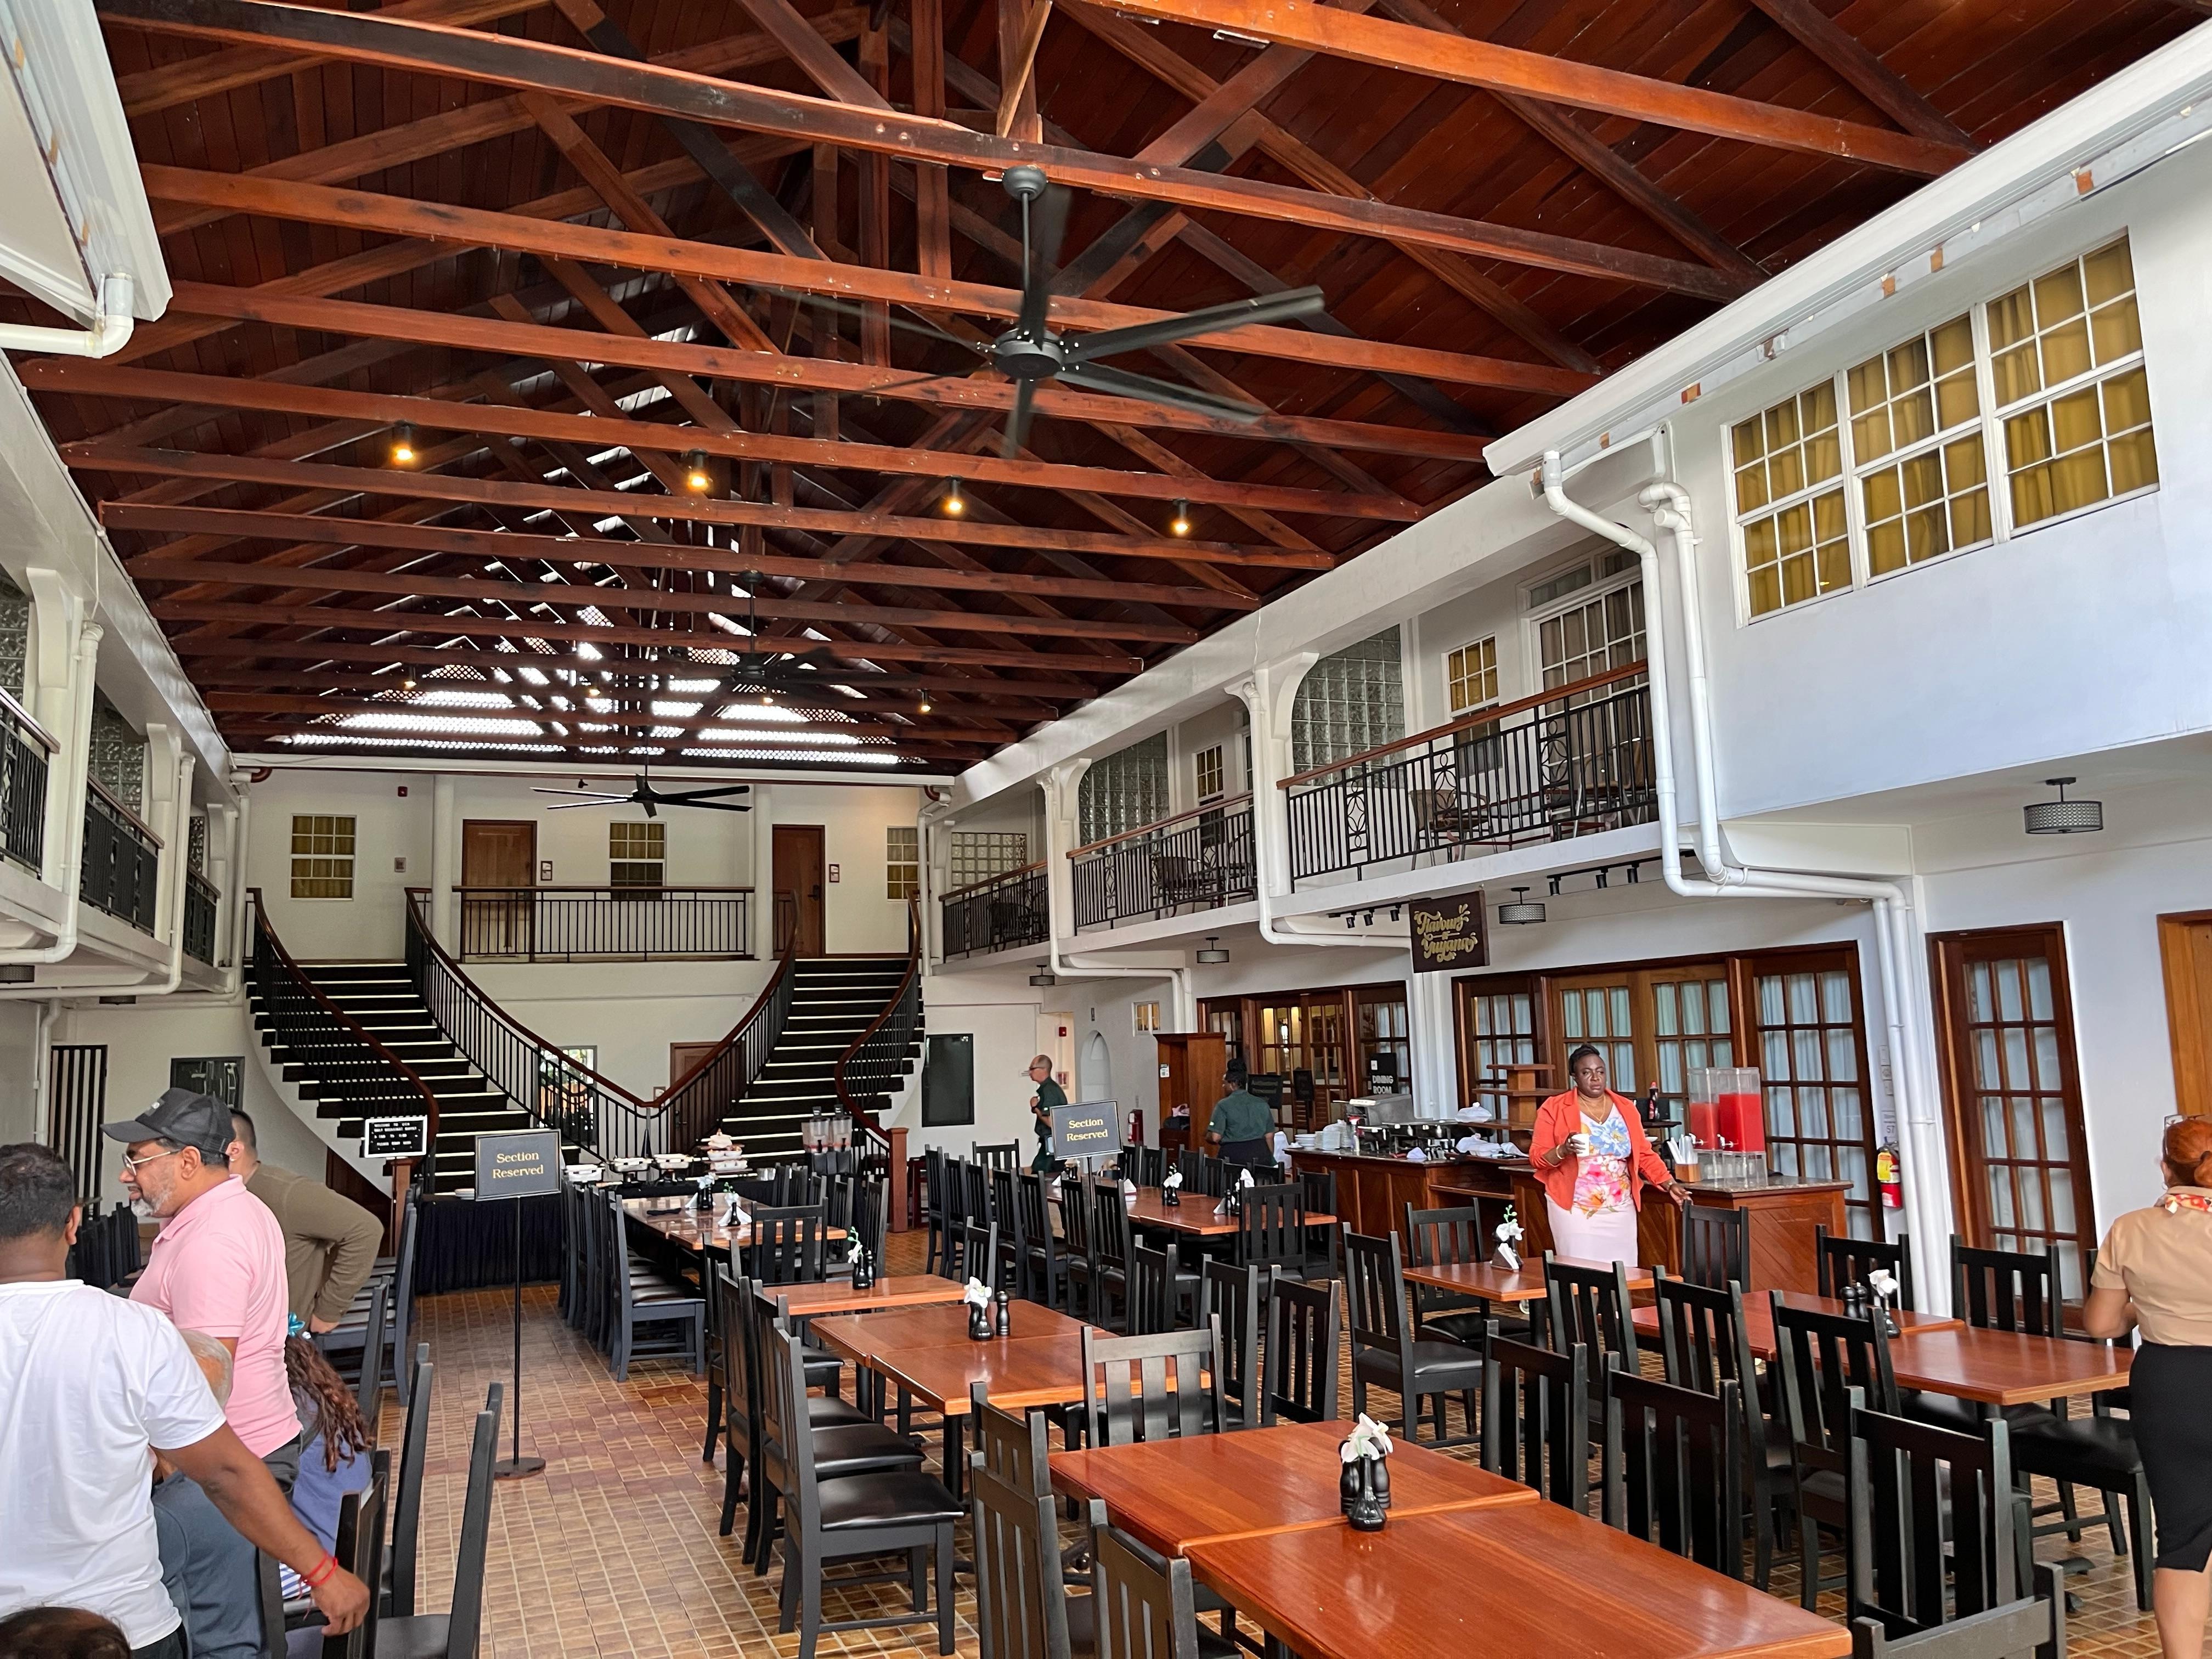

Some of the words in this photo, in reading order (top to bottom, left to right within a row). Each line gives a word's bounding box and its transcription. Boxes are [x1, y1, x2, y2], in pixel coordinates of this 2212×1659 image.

[1414, 910, 1470, 935] Flavours
[1373, 1086, 1392, 1094] ROOM
[1069, 1119, 1104, 1129] Section
[1066, 1128, 1108, 1142] Reserved
[496, 1152, 539, 1164] Section
[492, 1164, 544, 1179] Reserved
